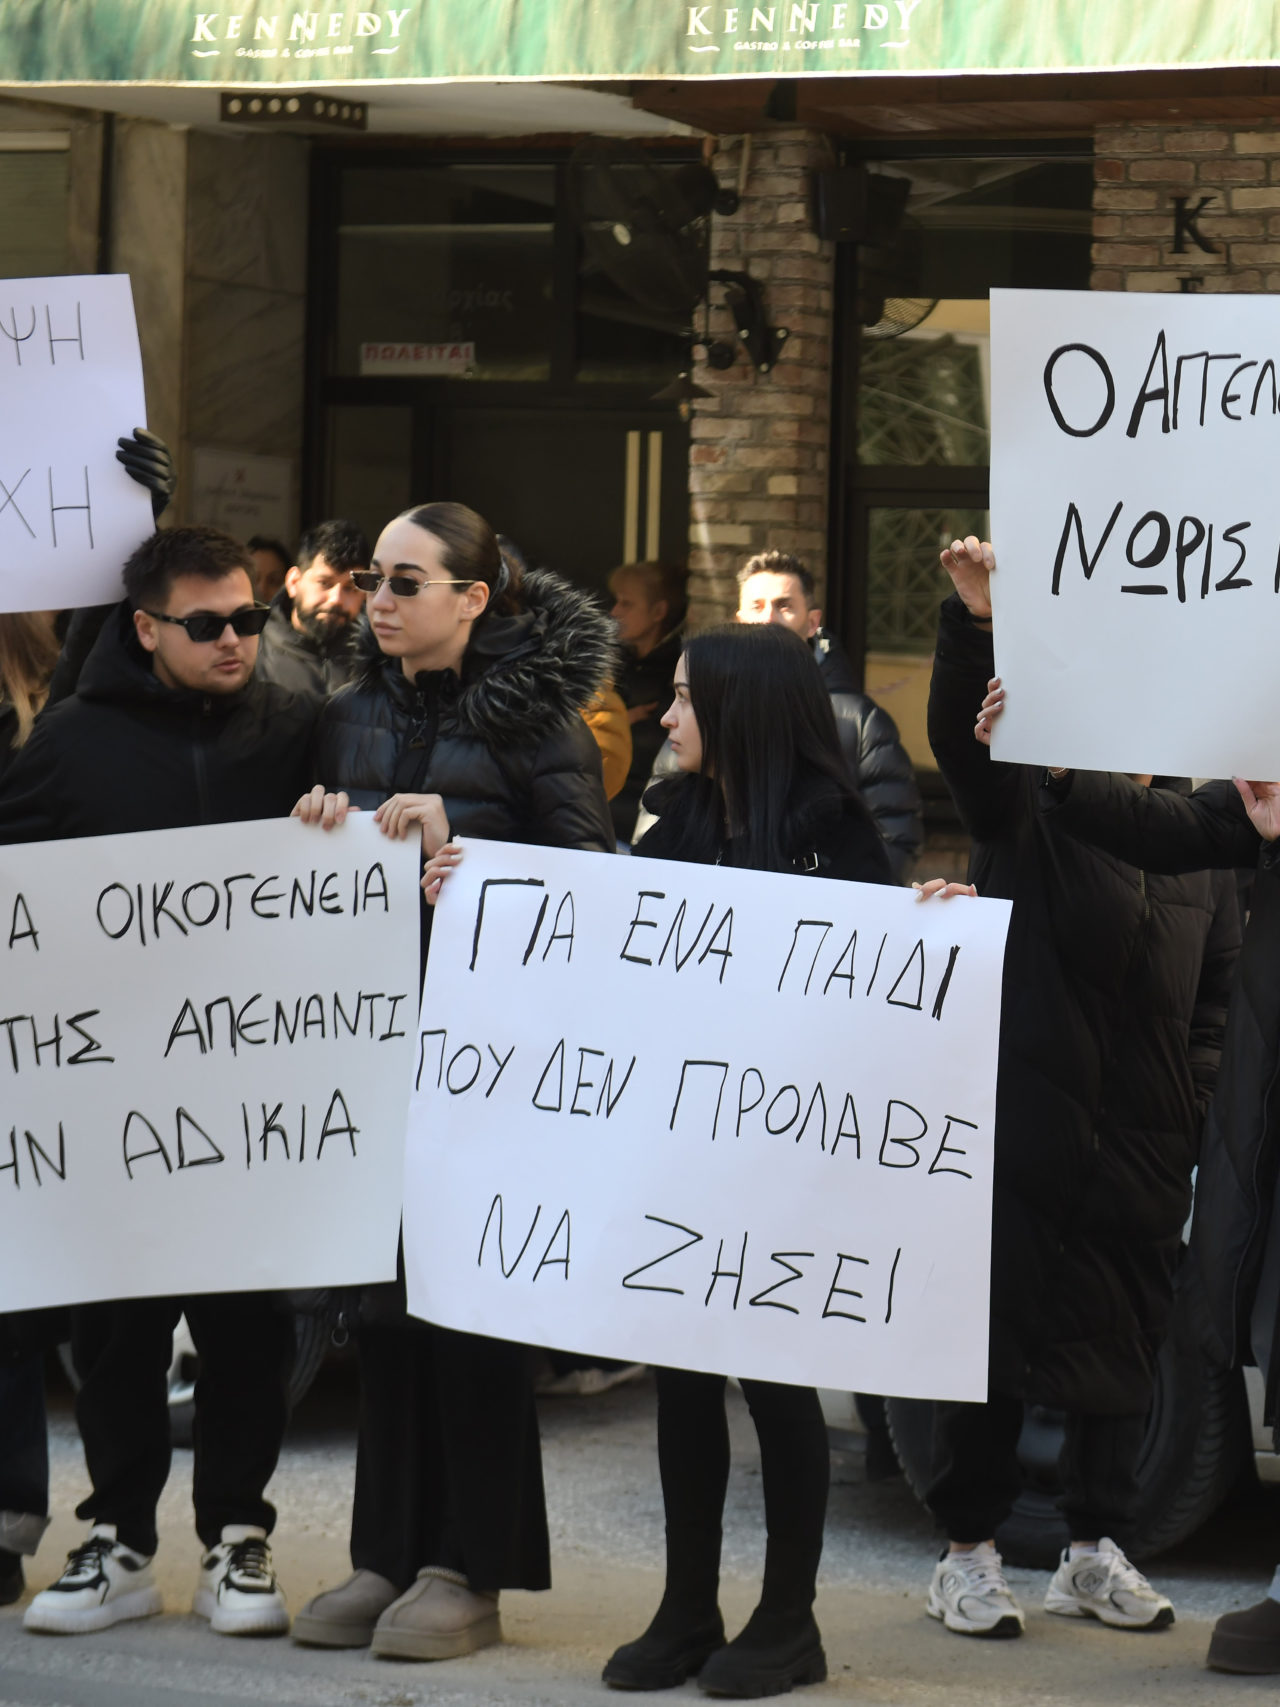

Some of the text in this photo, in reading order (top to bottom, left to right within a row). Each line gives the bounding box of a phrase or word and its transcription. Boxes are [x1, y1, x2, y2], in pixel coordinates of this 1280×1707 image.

[191, 8, 410, 44] KENNEDY
[686, 0, 921, 36] KENNEDY
[733, 40, 778, 51] GASTRO
[794, 39, 835, 50] COFFEE
[838, 37, 861, 48] BAR
[1043, 342, 1116, 439] Ο
[1050, 500, 1254, 604] ΝΩΡΙΣ
[96, 861, 390, 947] ΟΙΚΟΓΕΝΕΙΑ
[468, 877, 962, 1022] ΓΙΑ ΕΝΑ ΠΑΙΔΙ
[163, 989, 408, 1059] ΑΠΕΝΑΝΤΙ
[122, 1087, 361, 1181] ΑΔΙΚΙΑ
[415, 1028, 979, 1180] ΠΟΥ ΔΕΝ ΠΡΟΛΑΒΕ
[477, 1193, 902, 1325] ΝΑ ΖΗΣΕΙ
